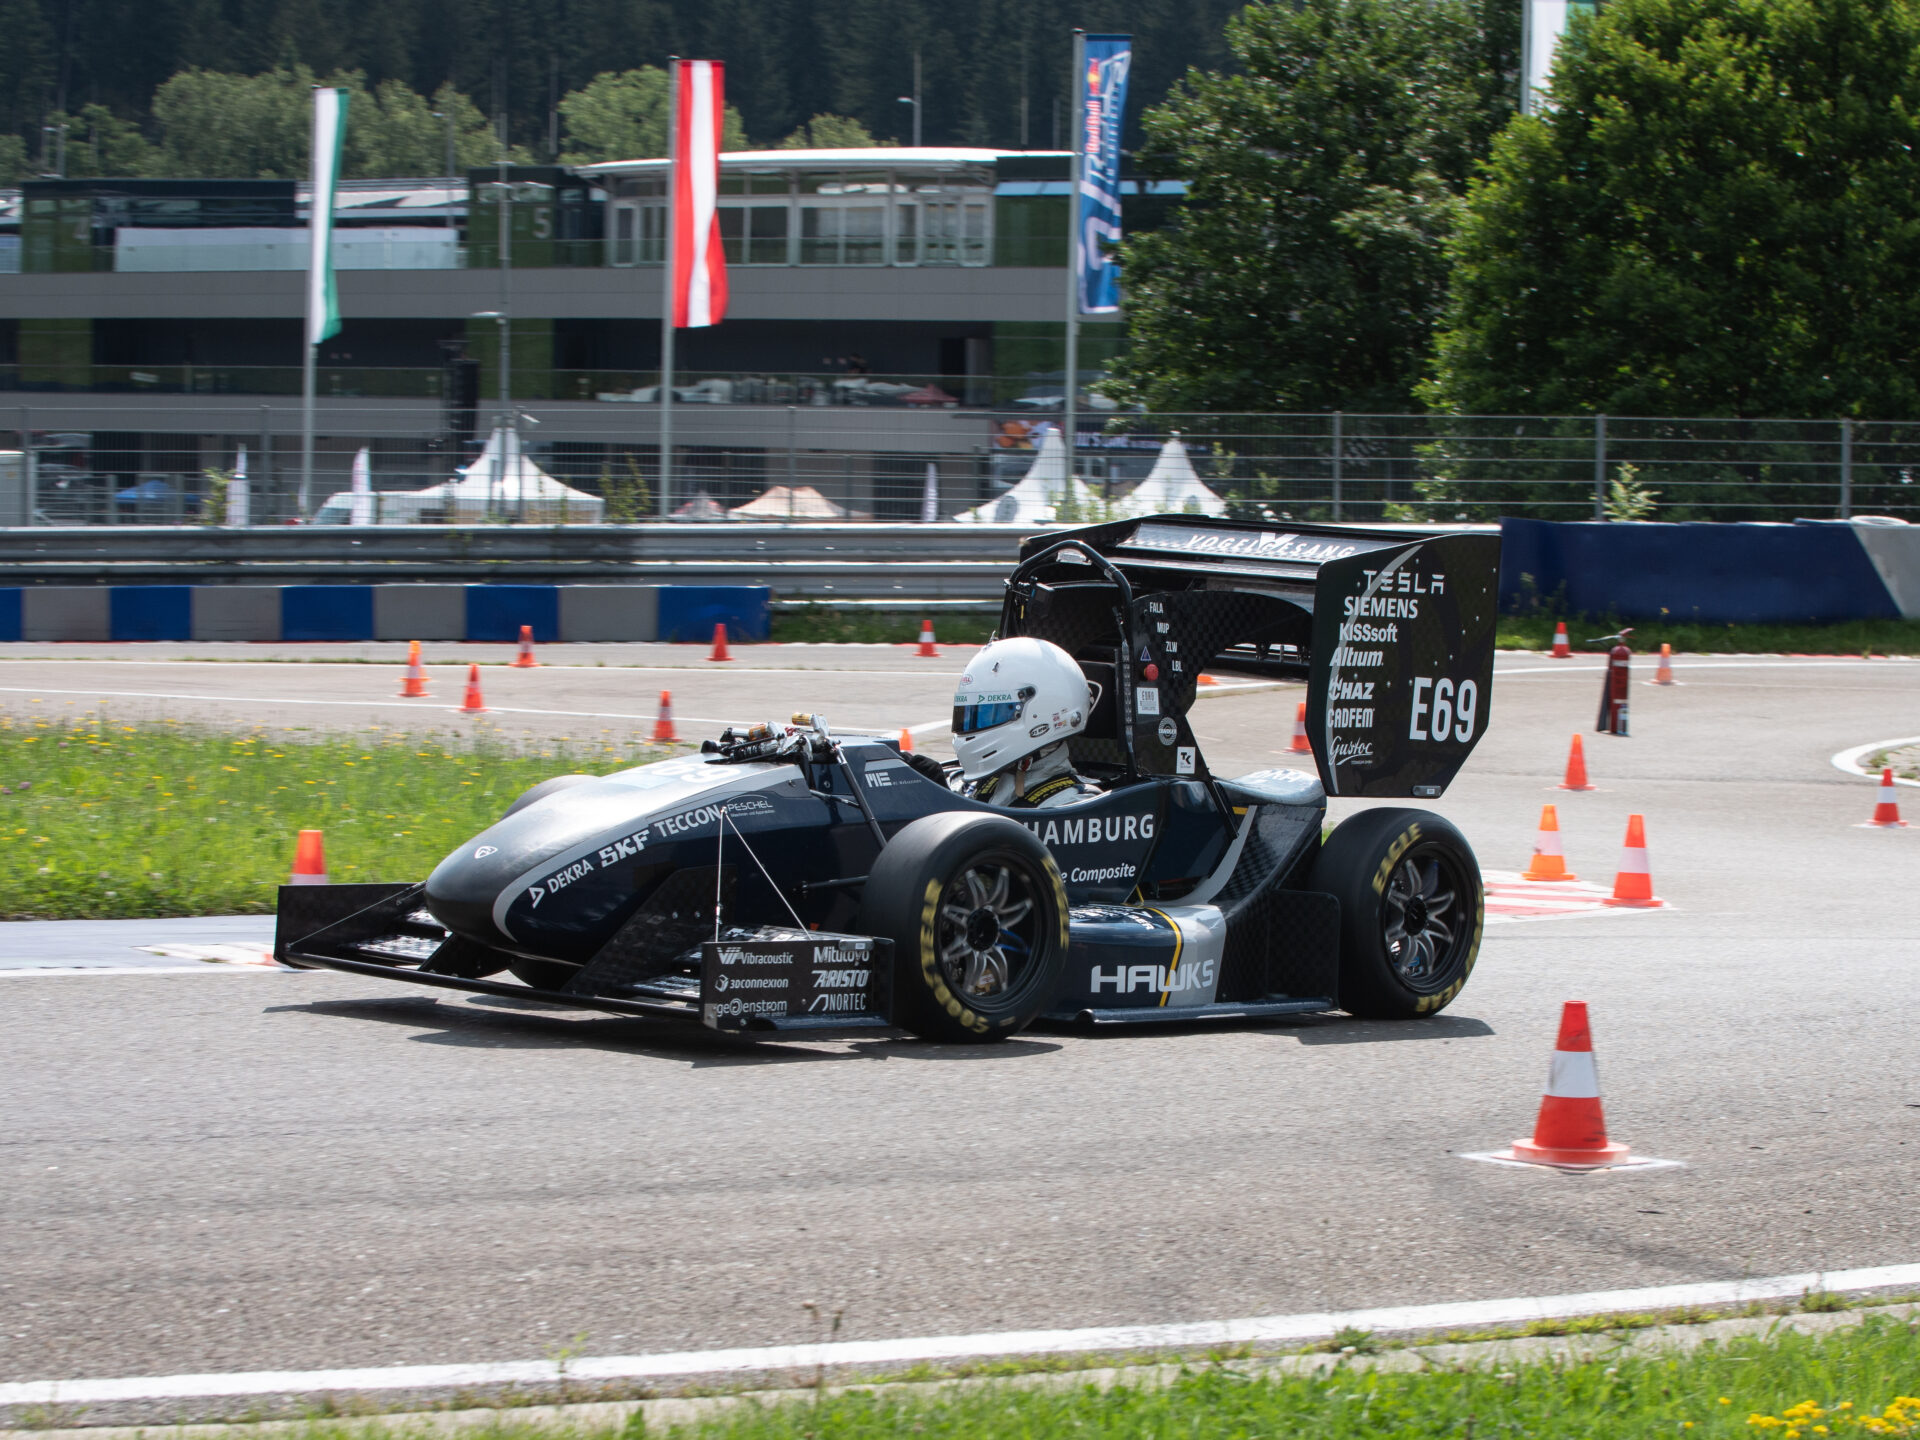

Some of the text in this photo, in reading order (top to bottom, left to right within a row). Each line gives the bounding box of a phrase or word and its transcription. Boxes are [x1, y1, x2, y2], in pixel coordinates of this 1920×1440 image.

[532, 207, 551, 238] 5
[1184, 534, 1357, 558] VOGELGESANG
[1363, 570, 1445, 594] TESLA
[1343, 596, 1418, 618] SIEMENS
[1339, 623, 1398, 642] KISSsoft
[1329, 647, 1382, 666] Altium
[987, 694, 1012, 702] DEKRA
[1327, 708, 1374, 728] CADFEM
[1409, 677, 1477, 743] E69
[865, 772, 892, 788] ME
[727, 800, 773, 812] PESCHEL
[547, 804, 722, 894] DEKRA SKF TECCON
[1071, 863, 1136, 884] Composite
[741, 952, 794, 965] Vibracoustic
[812, 970, 870, 988] ARISTO
[1091, 959, 1214, 993] HAWKS
[829, 993, 866, 1011] NORTEC
